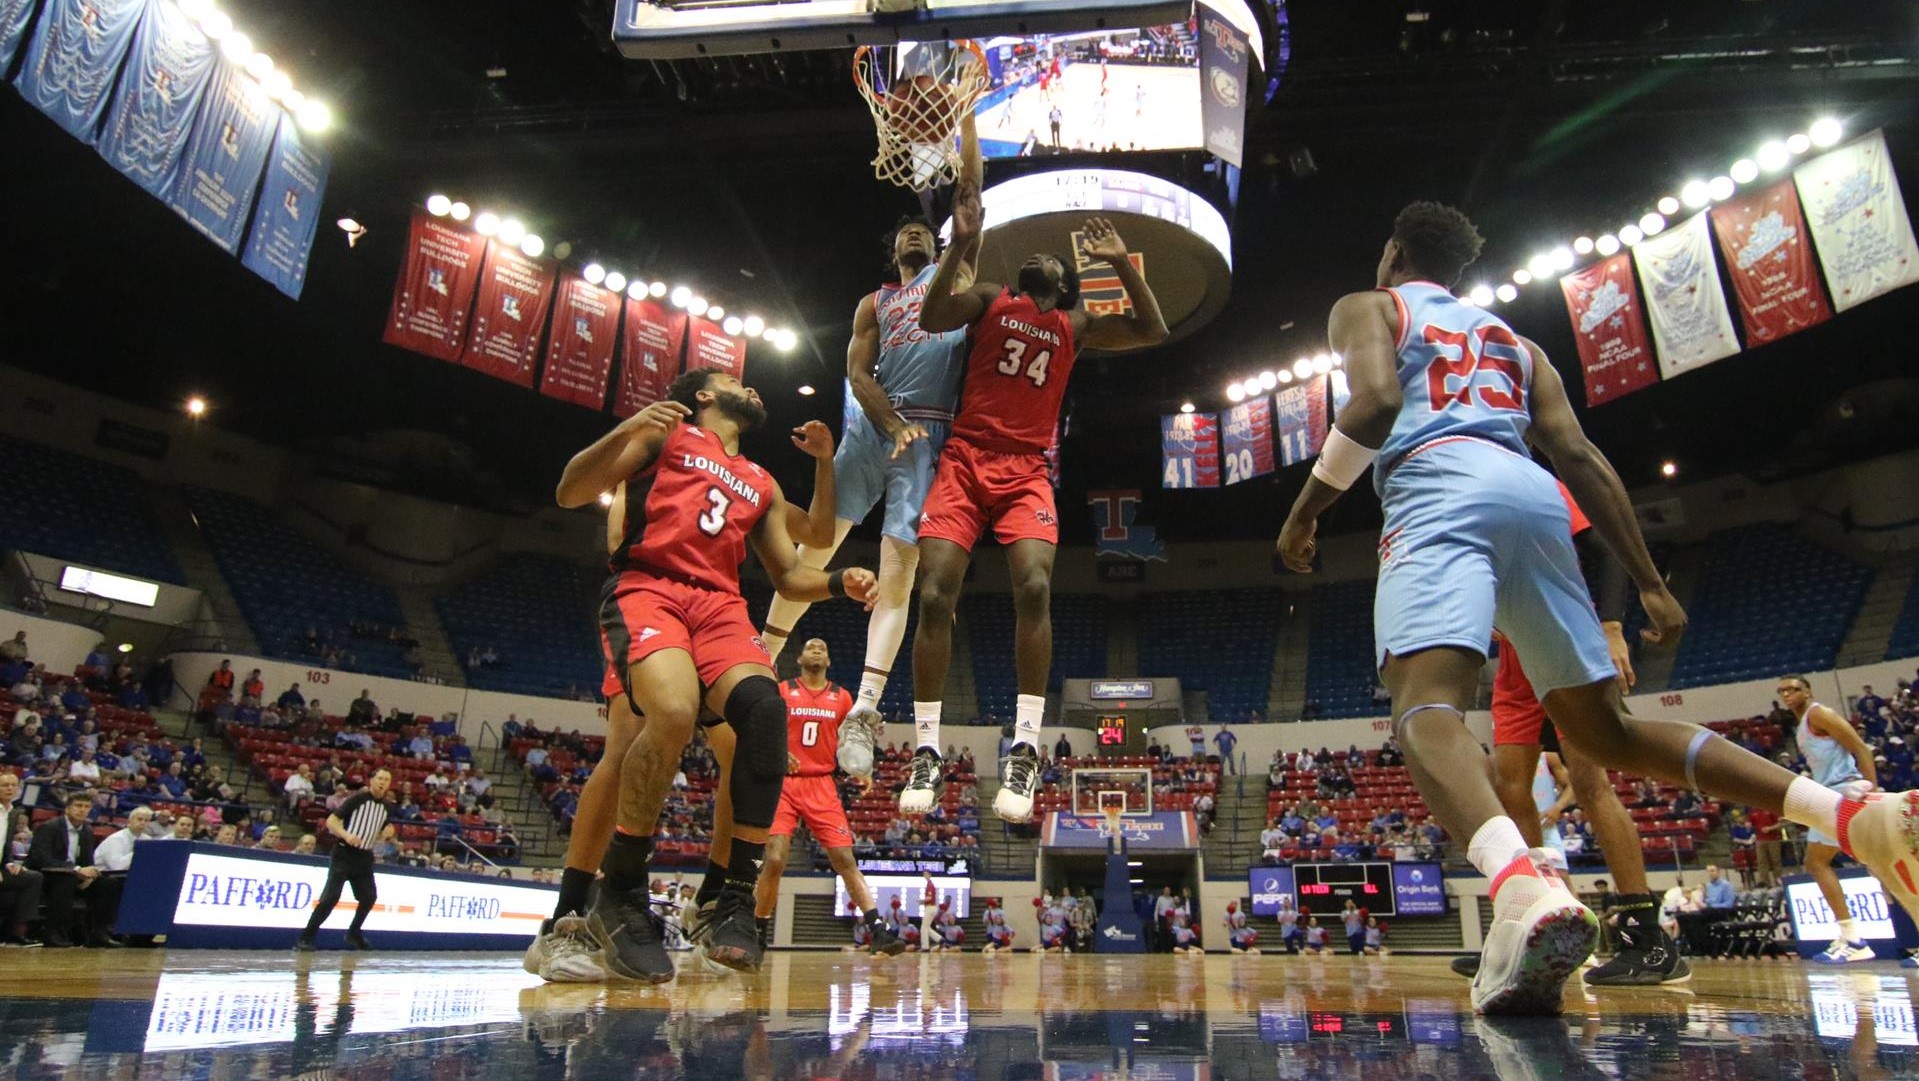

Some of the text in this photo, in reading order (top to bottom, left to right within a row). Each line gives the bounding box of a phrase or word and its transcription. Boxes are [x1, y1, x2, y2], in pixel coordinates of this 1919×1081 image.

[425, 221, 471, 244] LOUISIANA
[435, 234, 458, 248] TECH
[420, 237, 470, 260] UNIVERSITY
[420, 247, 467, 269] BULLDOGS
[496, 265, 542, 288] UNIVERSITY
[511, 262, 532, 276] TECH
[495, 274, 540, 296] BULLDOGS
[1761, 280, 1792, 300] NCAA
[1781, 287, 1809, 306] FOUR
[698, 343, 736, 361] UNIVERSITY
[708, 340, 726, 352] TECH
[1598, 344, 1627, 361] NCAA
[698, 351, 734, 368] BULLDOGS
[998, 338, 1051, 387] 34
[1421, 323, 1524, 413] 25
[1587, 345, 1642, 374] FINAL FOUR
[1282, 428, 1307, 467] 11
[1164, 457, 1192, 488] 41
[1225, 448, 1253, 486] 20
[684, 454, 760, 507] LOUISIANA
[699, 487, 731, 536] 3
[306, 669, 330, 685] 103
[1660, 693, 1684, 708] 108
[790, 707, 836, 719] LOUISIANA
[801, 721, 820, 747] 0
[1372, 719, 1390, 731] 107
[1102, 728, 1122, 745] 24
[857, 859, 945, 872] LOUISIANA TECH
[1300, 884, 1330, 894] LA TECH
[1397, 884, 1440, 895] Origin Bank
[1252, 893, 1293, 905] PEPSI
